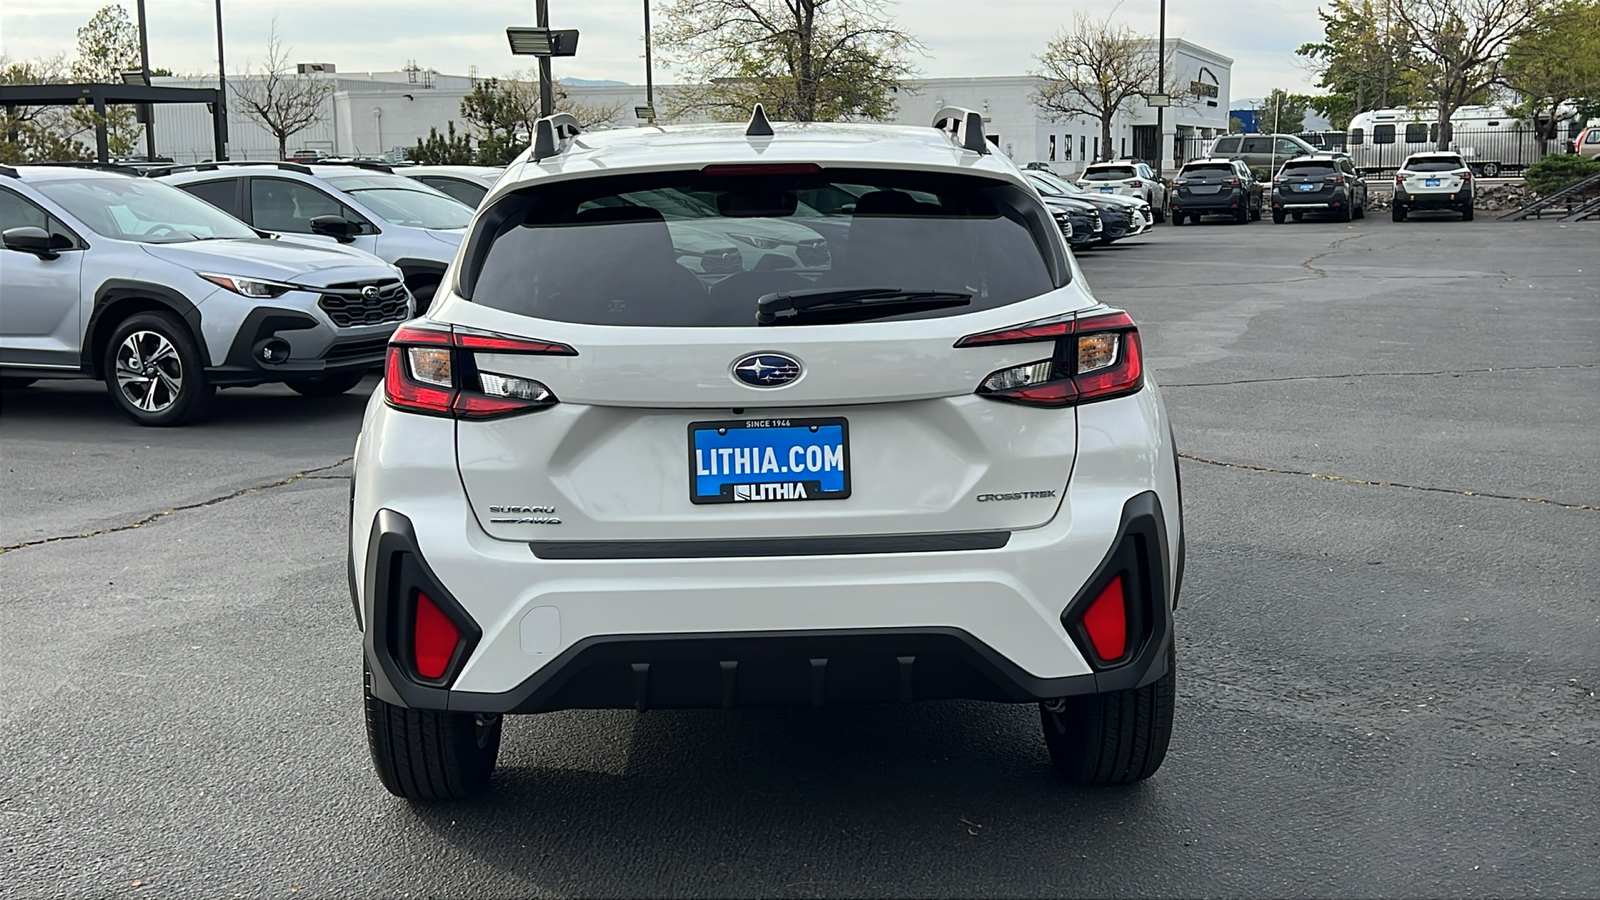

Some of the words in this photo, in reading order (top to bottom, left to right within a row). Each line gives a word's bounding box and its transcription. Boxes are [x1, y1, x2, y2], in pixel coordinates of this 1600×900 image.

[746, 420, 770, 428] SINCE
[772, 419, 791, 427] 1946
[696, 444, 844, 476] LITHIA.COM
[751, 482, 807, 500] LITHIA
[976, 490, 1056, 502] CROSSTREK
[489, 505, 556, 514] SUBARU
[517, 517, 562, 525] AWD
